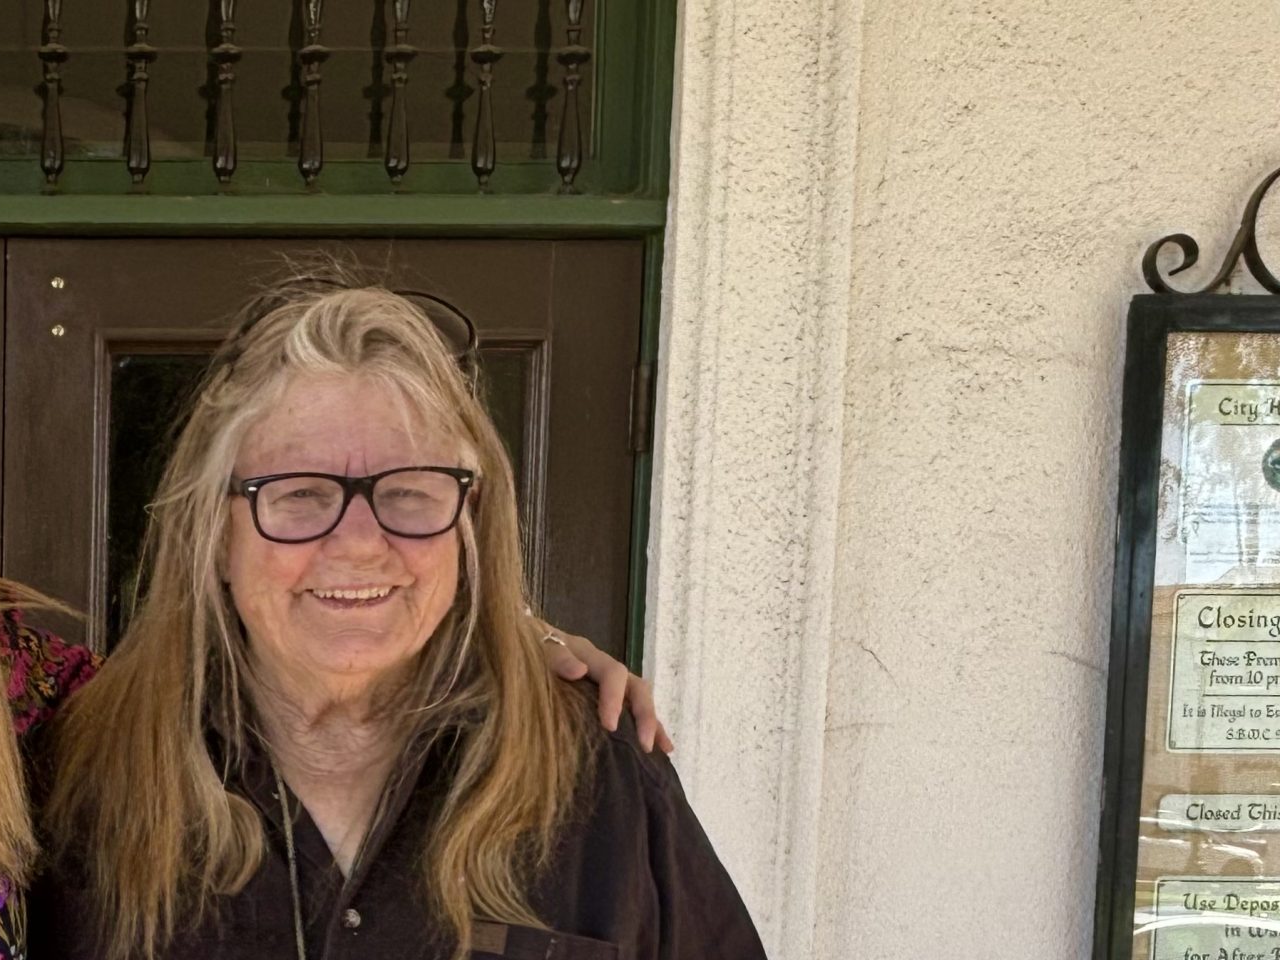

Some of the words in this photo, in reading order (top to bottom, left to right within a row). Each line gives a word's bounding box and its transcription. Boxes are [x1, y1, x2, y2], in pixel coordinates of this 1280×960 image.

[1218, 397, 1259, 423] City
[1198, 605, 1280, 638] Closing
[1199, 650, 1240, 667] These
[1209, 669, 1244, 688] from
[1247, 670, 1263, 685] 10
[1249, 708, 1262, 718] to
[1186, 803, 1242, 821] Closed
[1183, 892, 1217, 911] Use
[1225, 923, 1241, 938] in
